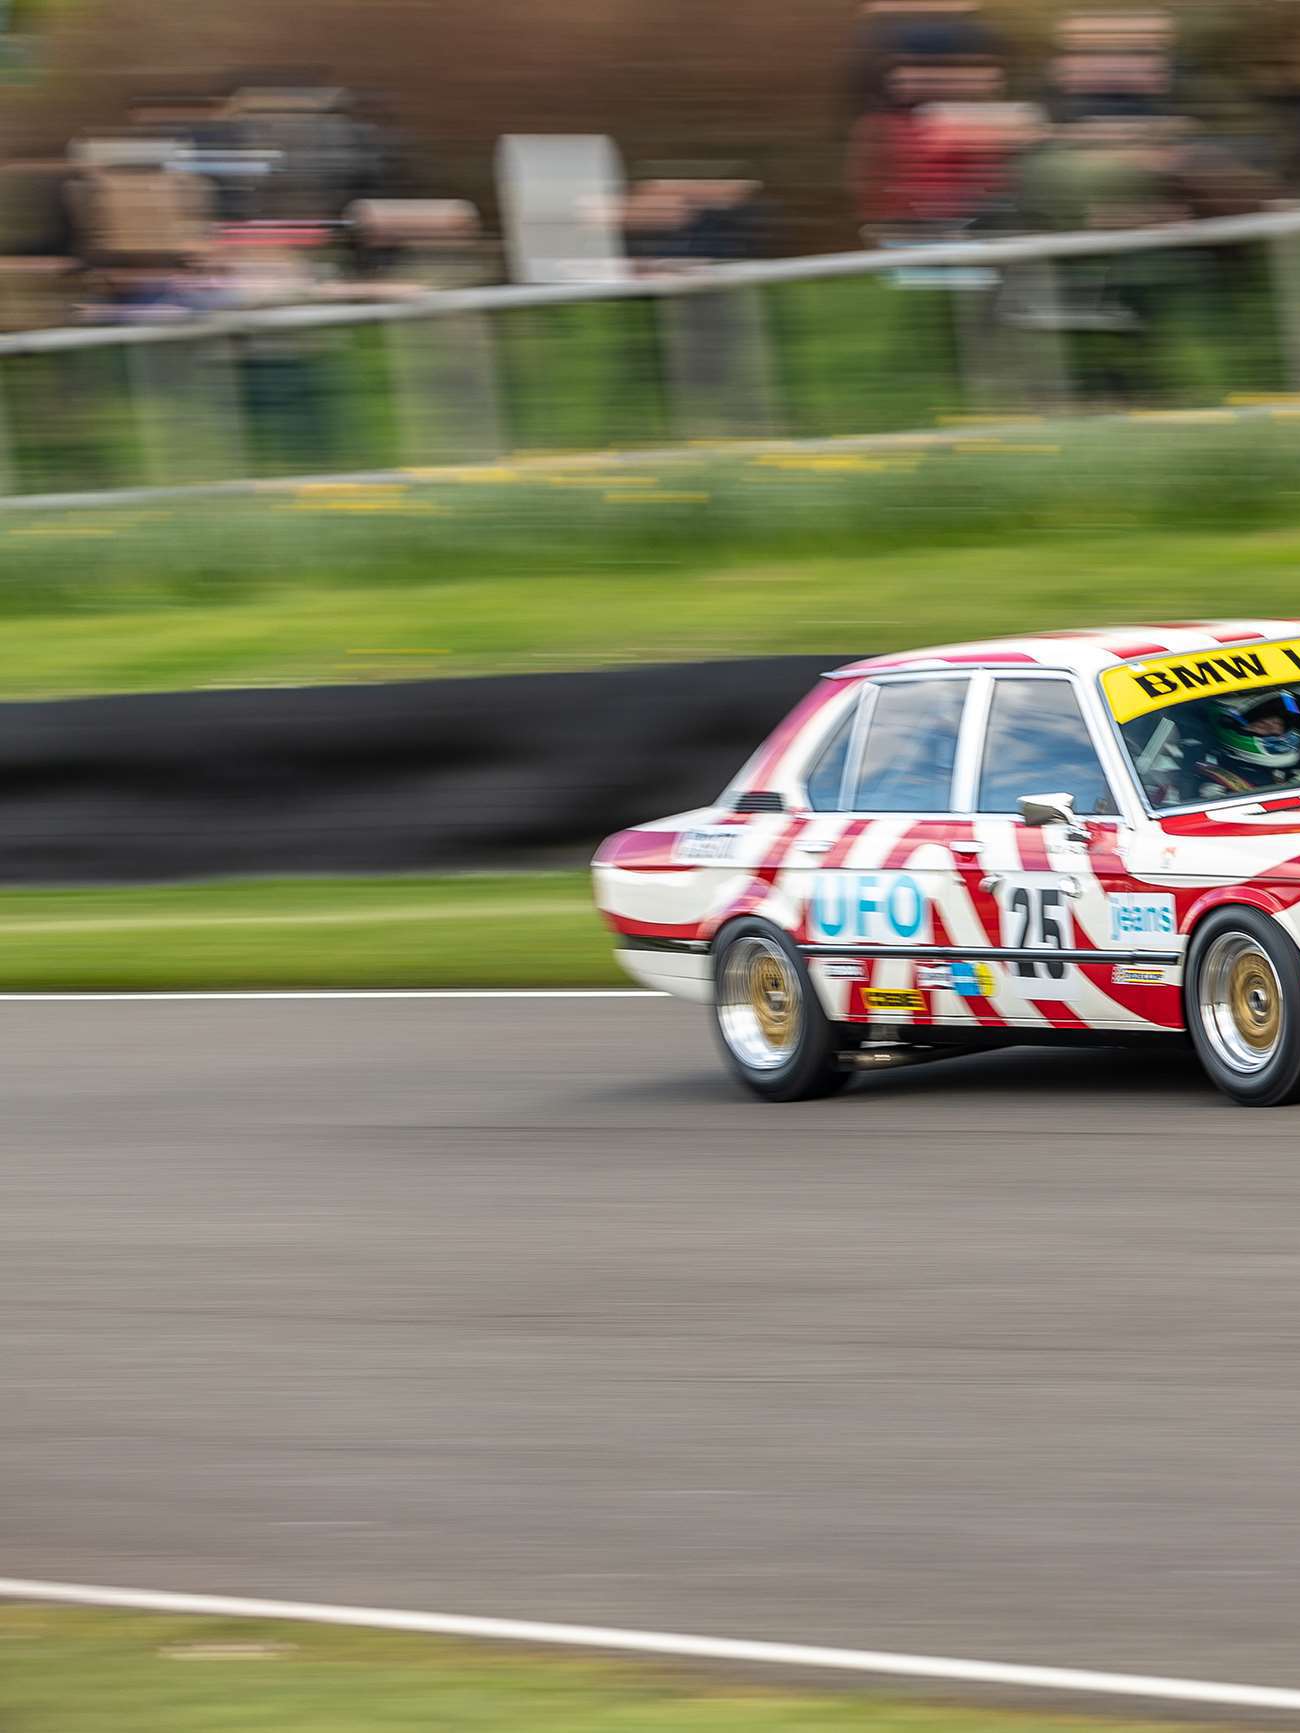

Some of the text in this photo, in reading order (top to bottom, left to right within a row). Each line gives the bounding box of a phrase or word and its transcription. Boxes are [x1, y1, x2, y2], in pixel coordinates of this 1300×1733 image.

[1131, 653, 1269, 699] BMW
[812, 875, 923, 937] UFO
[1010, 888, 1066, 979] 25
